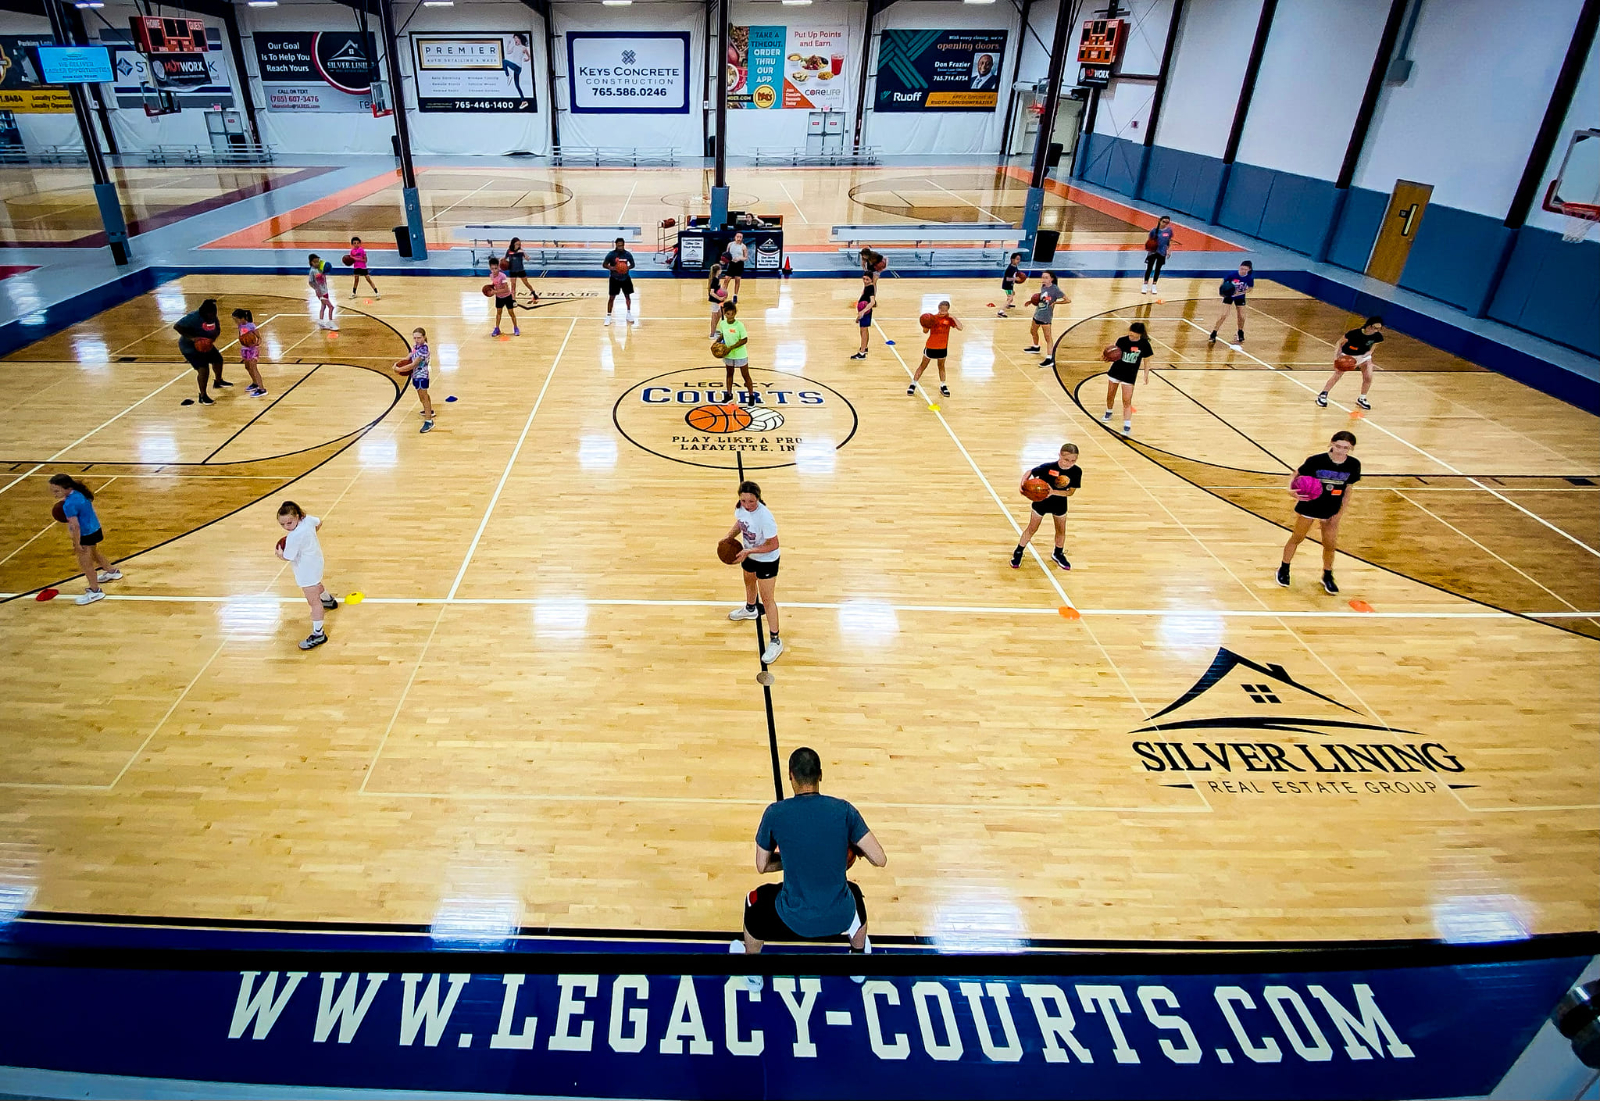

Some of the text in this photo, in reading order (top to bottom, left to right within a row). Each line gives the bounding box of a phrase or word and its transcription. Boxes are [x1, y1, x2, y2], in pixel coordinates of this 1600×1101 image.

[188, 20, 203, 30] GUEST
[808, 31, 818, 40] Up
[283, 42, 300, 50] Goal
[937, 41, 973, 51] opening
[279, 54, 294, 62] Help
[580, 67, 679, 76] KEYS CONCRETE
[592, 88, 667, 96] 765.586.0246
[893, 92, 922, 101] Ruoff
[642, 387, 824, 405] COURTS
[1132, 741, 1466, 772] SILVER LINING
[1209, 782, 1439, 794] REAL ESTATE GROUP
[228, 971, 1416, 1064] WWW.LEGACY-COURTS.COM
